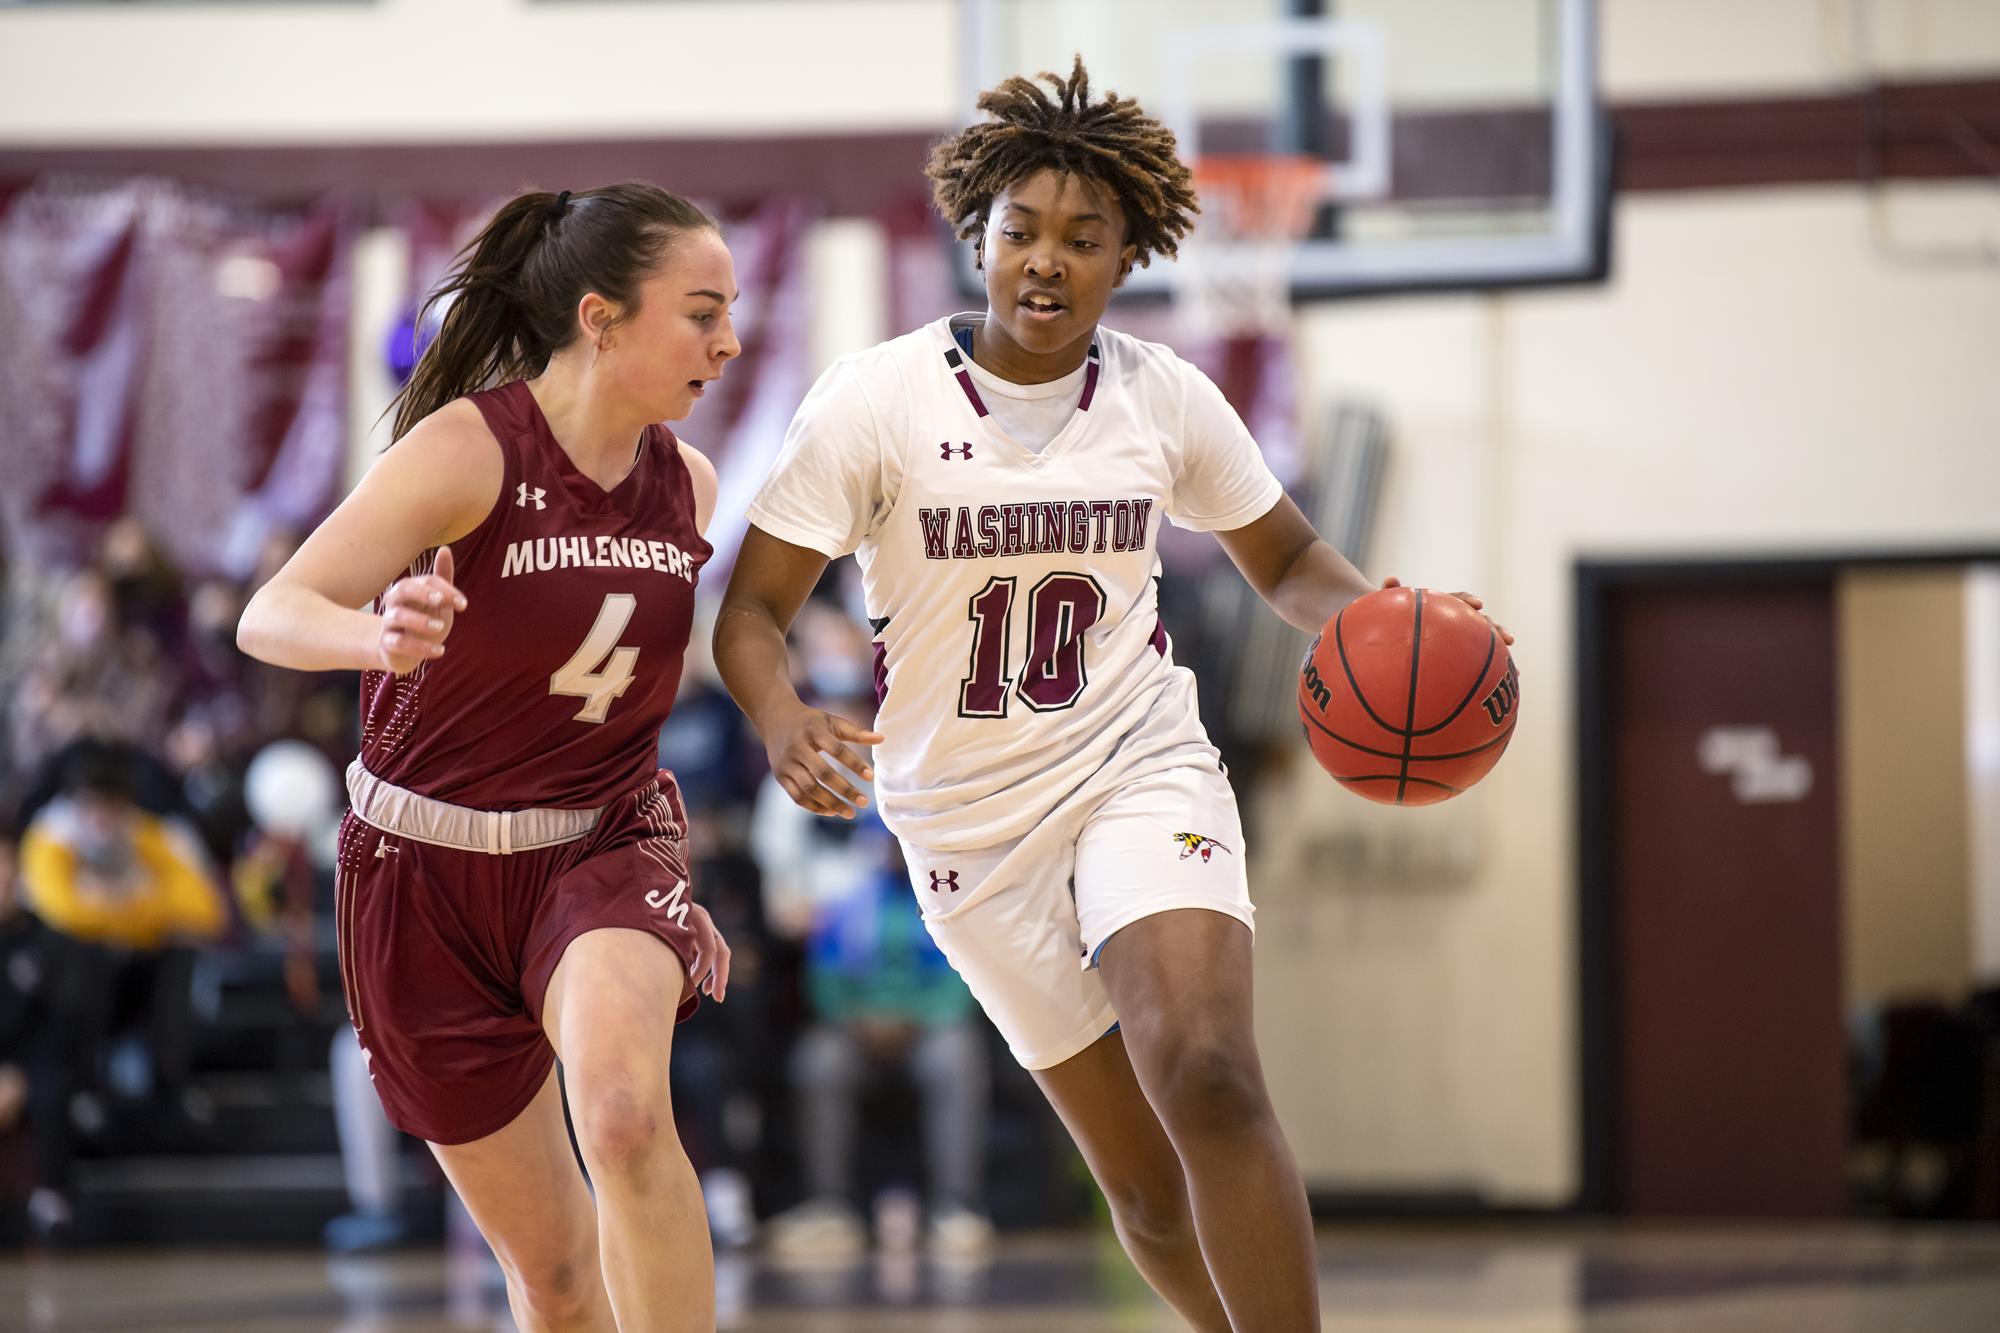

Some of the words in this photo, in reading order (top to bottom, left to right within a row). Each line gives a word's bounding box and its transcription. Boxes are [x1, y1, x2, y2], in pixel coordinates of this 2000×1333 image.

[919, 499, 1152, 559] WASHINGTON
[549, 593, 640, 724] 4
[957, 571, 1107, 718] 10
